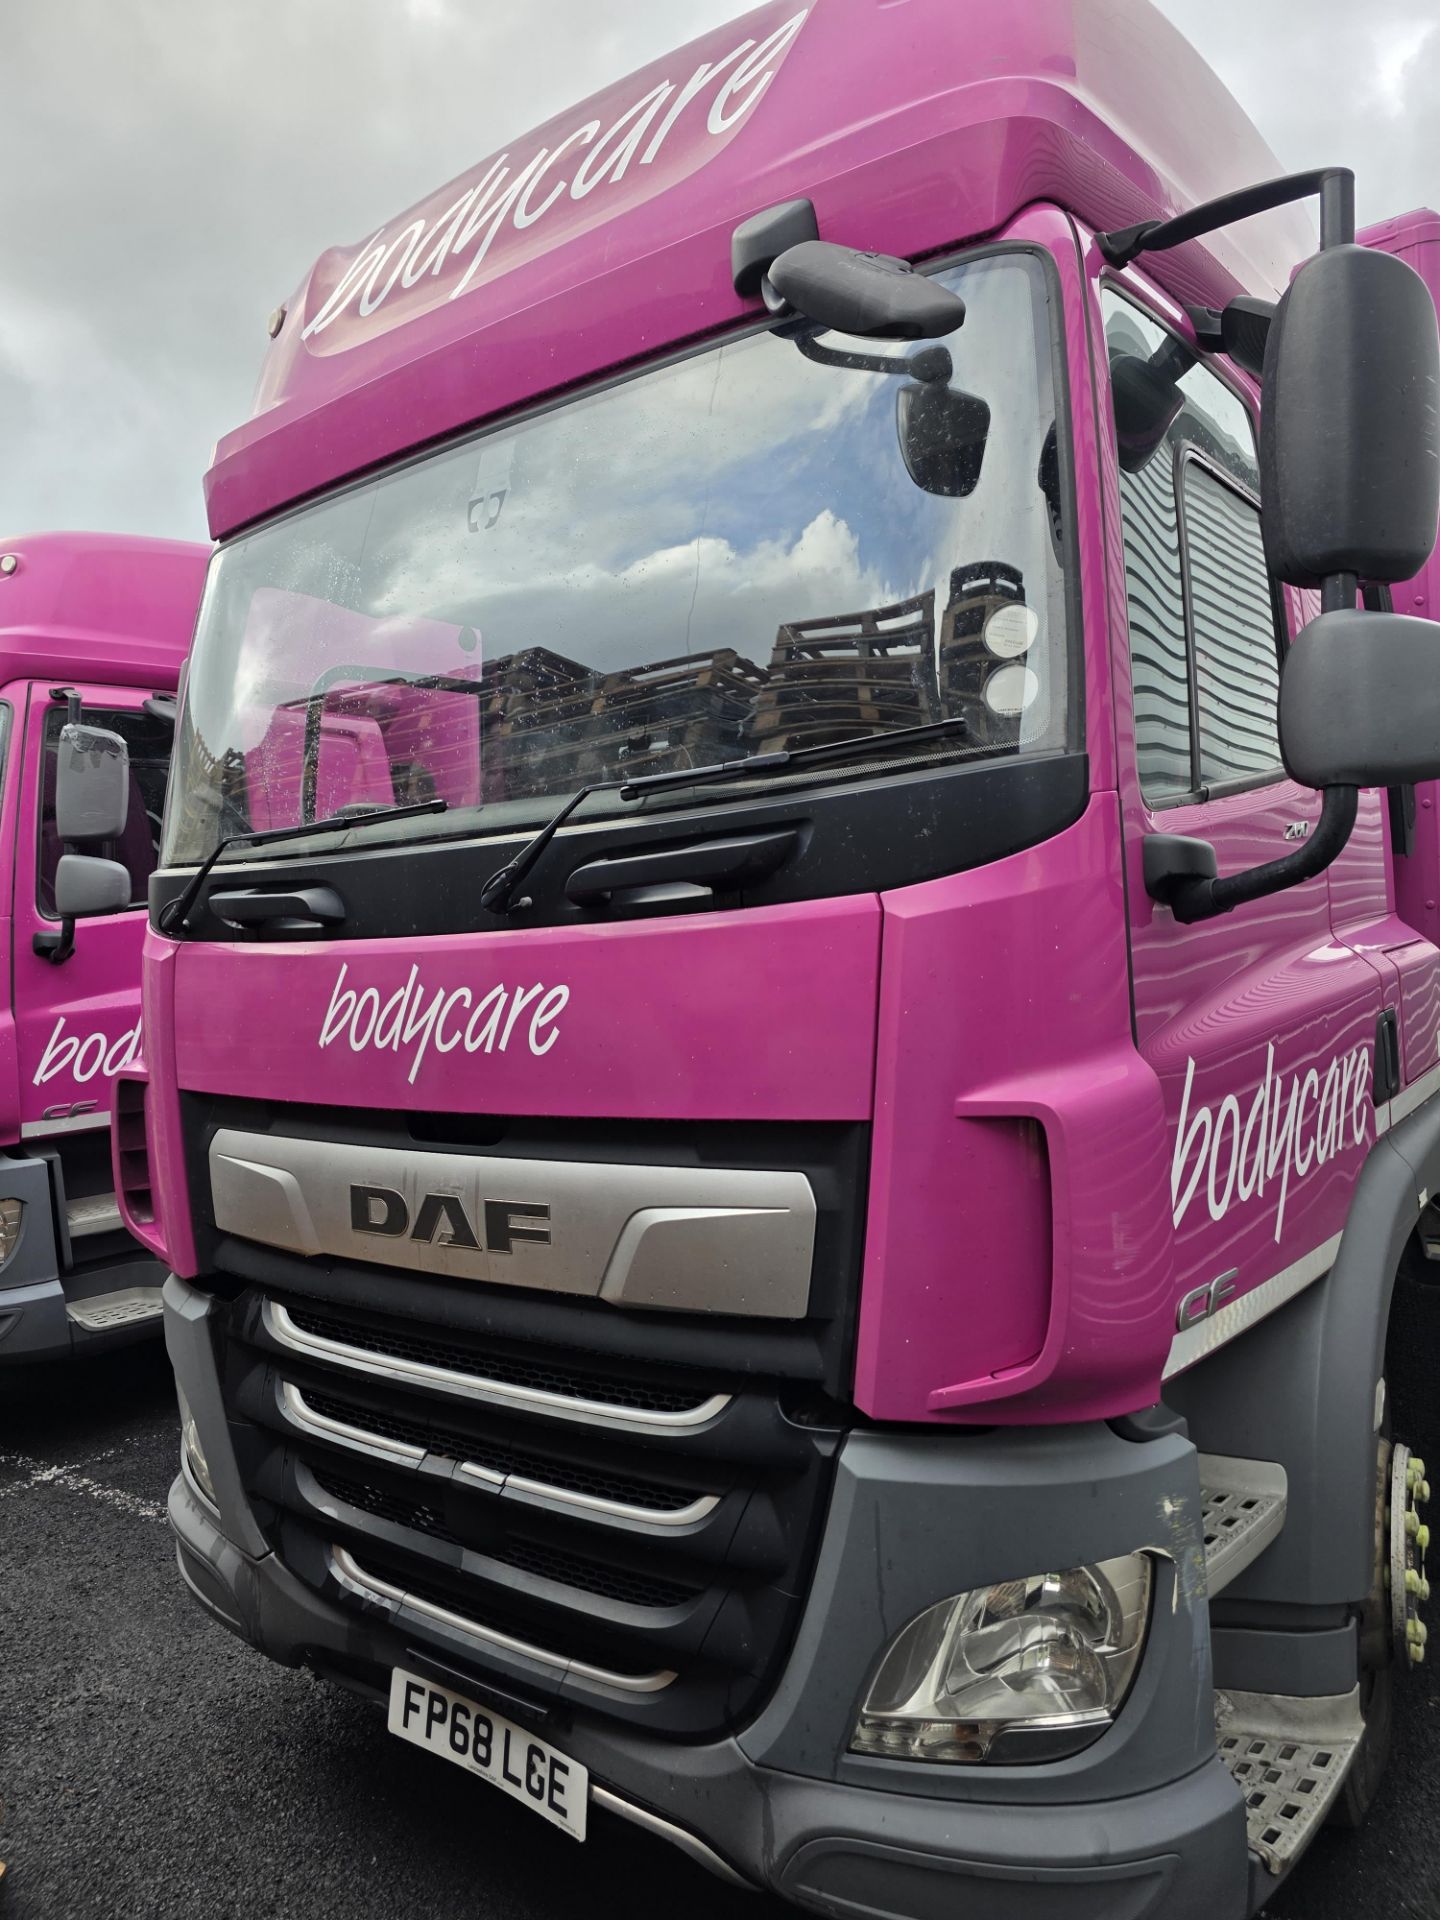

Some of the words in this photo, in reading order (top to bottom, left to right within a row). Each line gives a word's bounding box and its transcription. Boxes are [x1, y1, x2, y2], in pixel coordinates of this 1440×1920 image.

[301, 8, 809, 341] bodycare
[32, 1016, 142, 1086] bod
[318, 962, 570, 1085] bodycare
[42, 1099, 99, 1121] CF
[1170, 1041, 1369, 1244] bodycare
[350, 1183, 551, 1255] DAF
[1177, 1267, 1240, 1332] CF
[403, 1680, 494, 1768] FP68
[502, 1727, 570, 1820] LGE
